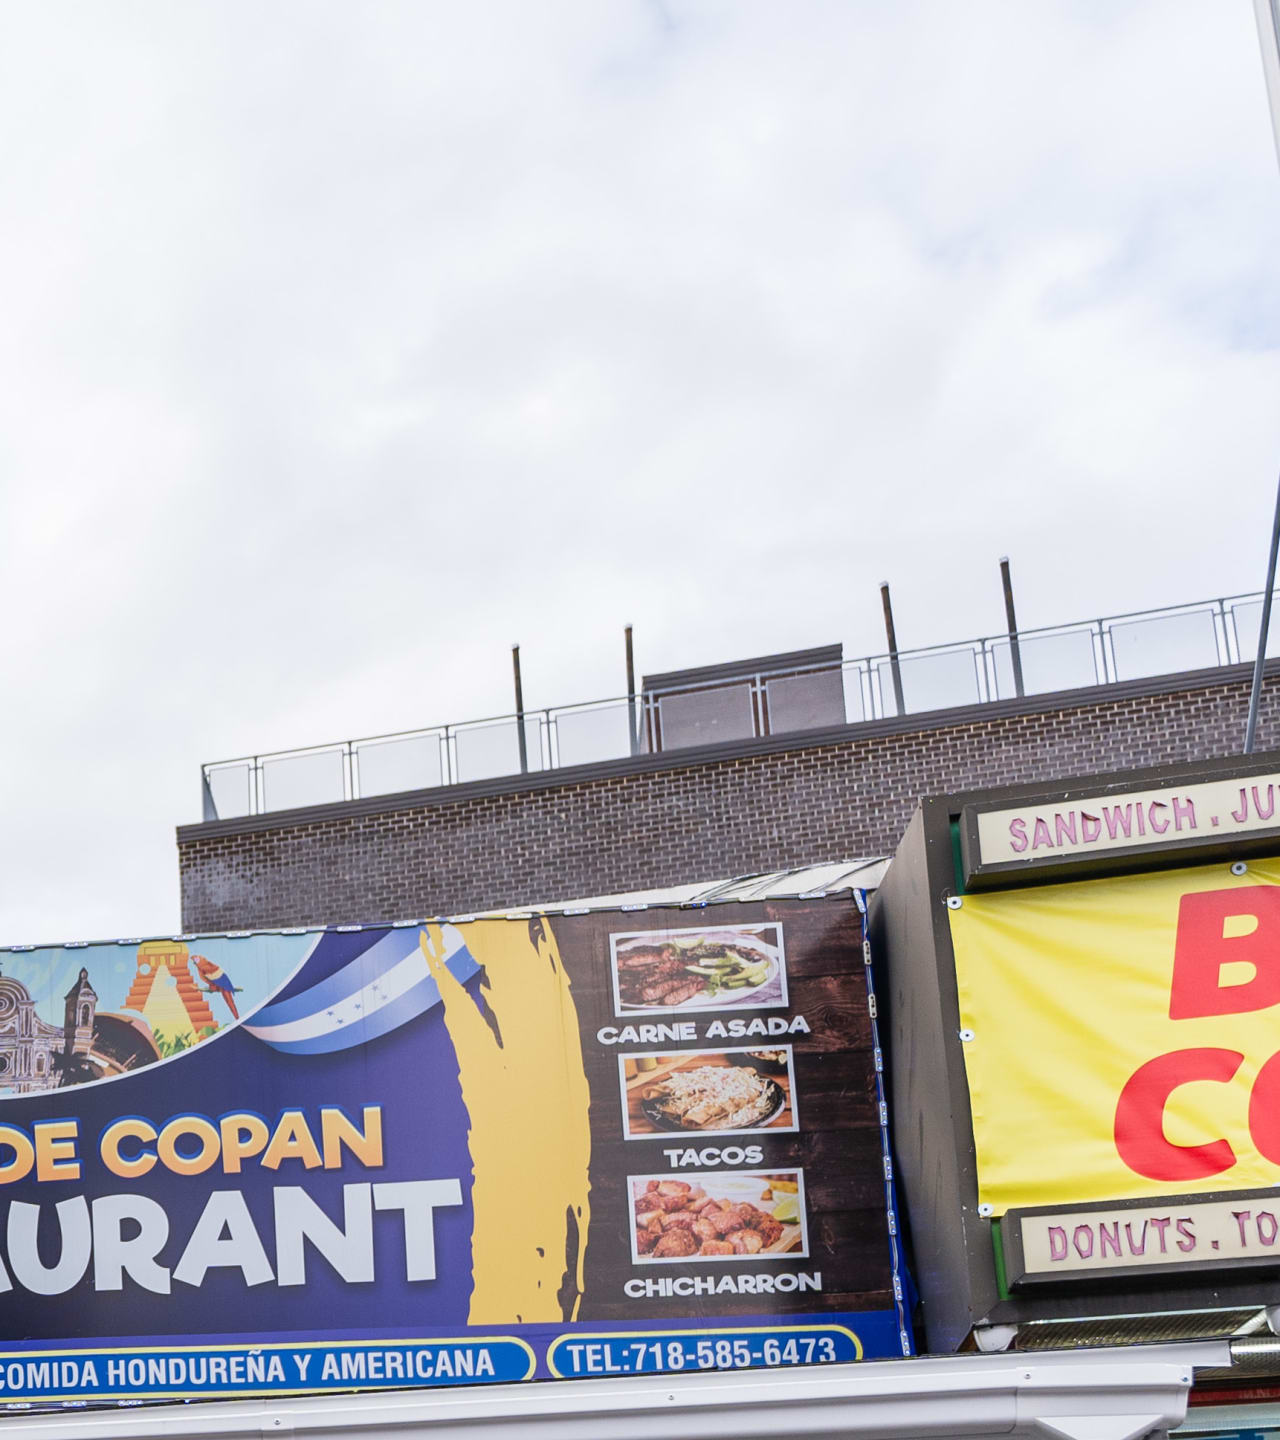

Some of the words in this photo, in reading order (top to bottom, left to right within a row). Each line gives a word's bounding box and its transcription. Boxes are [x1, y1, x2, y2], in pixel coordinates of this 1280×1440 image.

[1009, 797, 1197, 852] SANDWICH
[1231, 783, 1280, 823] JU
[596, 1021, 698, 1045] CARNE
[705, 1014, 811, 1039] ASADA
[1114, 1047, 1280, 1182] C
[99, 1105, 385, 1180] COPAN
[663, 1145, 764, 1168] TACOS
[623, 1271, 822, 1299] CHICHARRON
[107, 1348, 286, 1387] HONDUREÑA
[293, 1354, 314, 1381] Y
[321, 1348, 495, 1381] AMERICANA
[566, 1337, 837, 1373] TEL:718-585-6473
